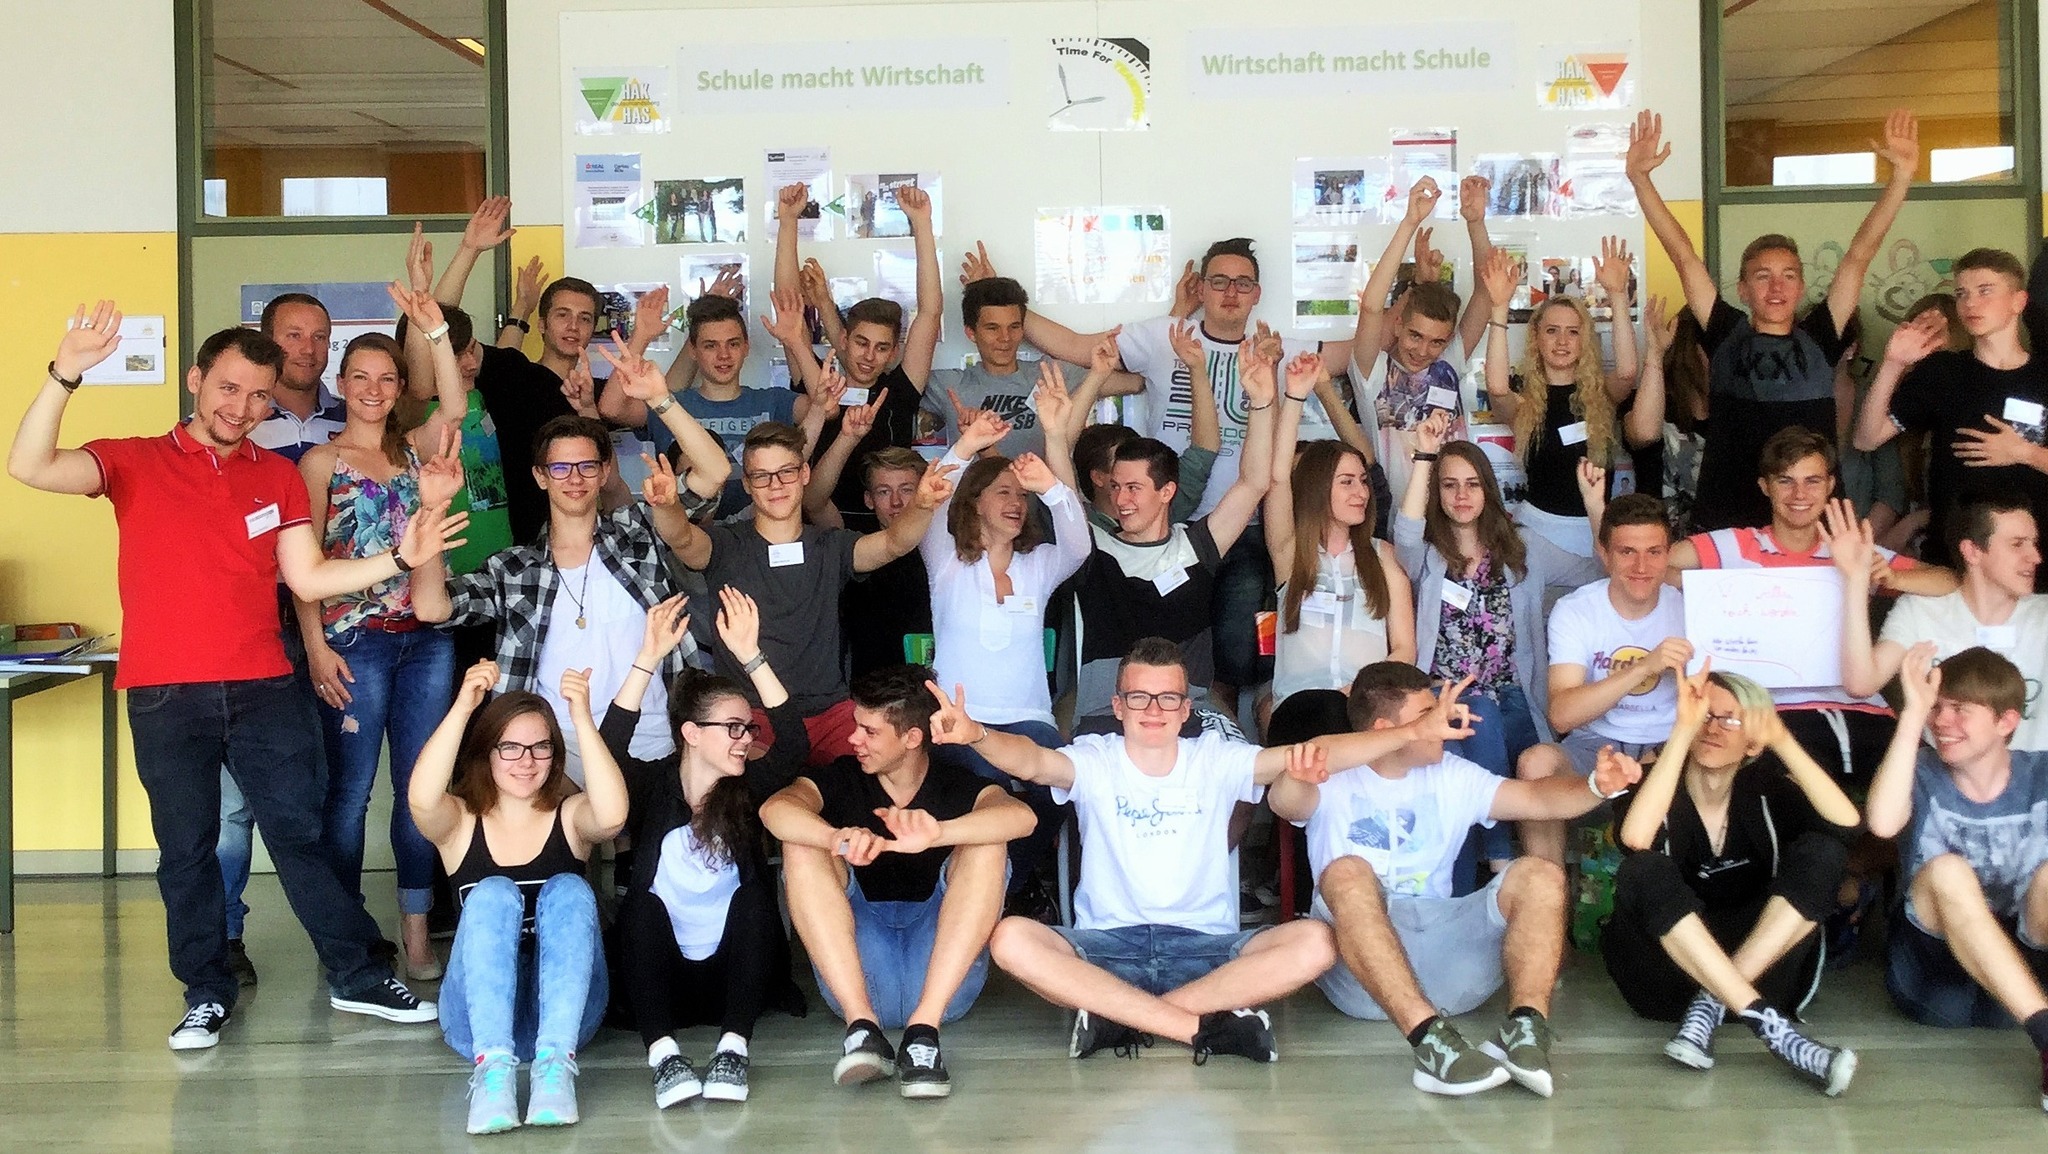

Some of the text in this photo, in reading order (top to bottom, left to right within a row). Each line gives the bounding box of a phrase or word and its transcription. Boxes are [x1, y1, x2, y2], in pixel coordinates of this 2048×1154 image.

[1056, 47, 1113, 64] Time For
[1201, 46, 1491, 76] Wirtschaft macht Schule
[697, 62, 985, 91] Schule macht Wirtschaft
[622, 83, 651, 101] HAK
[622, 106, 652, 124] HAS
[980, 394, 1029, 413] NIKE
[1013, 413, 1036, 430] SB
